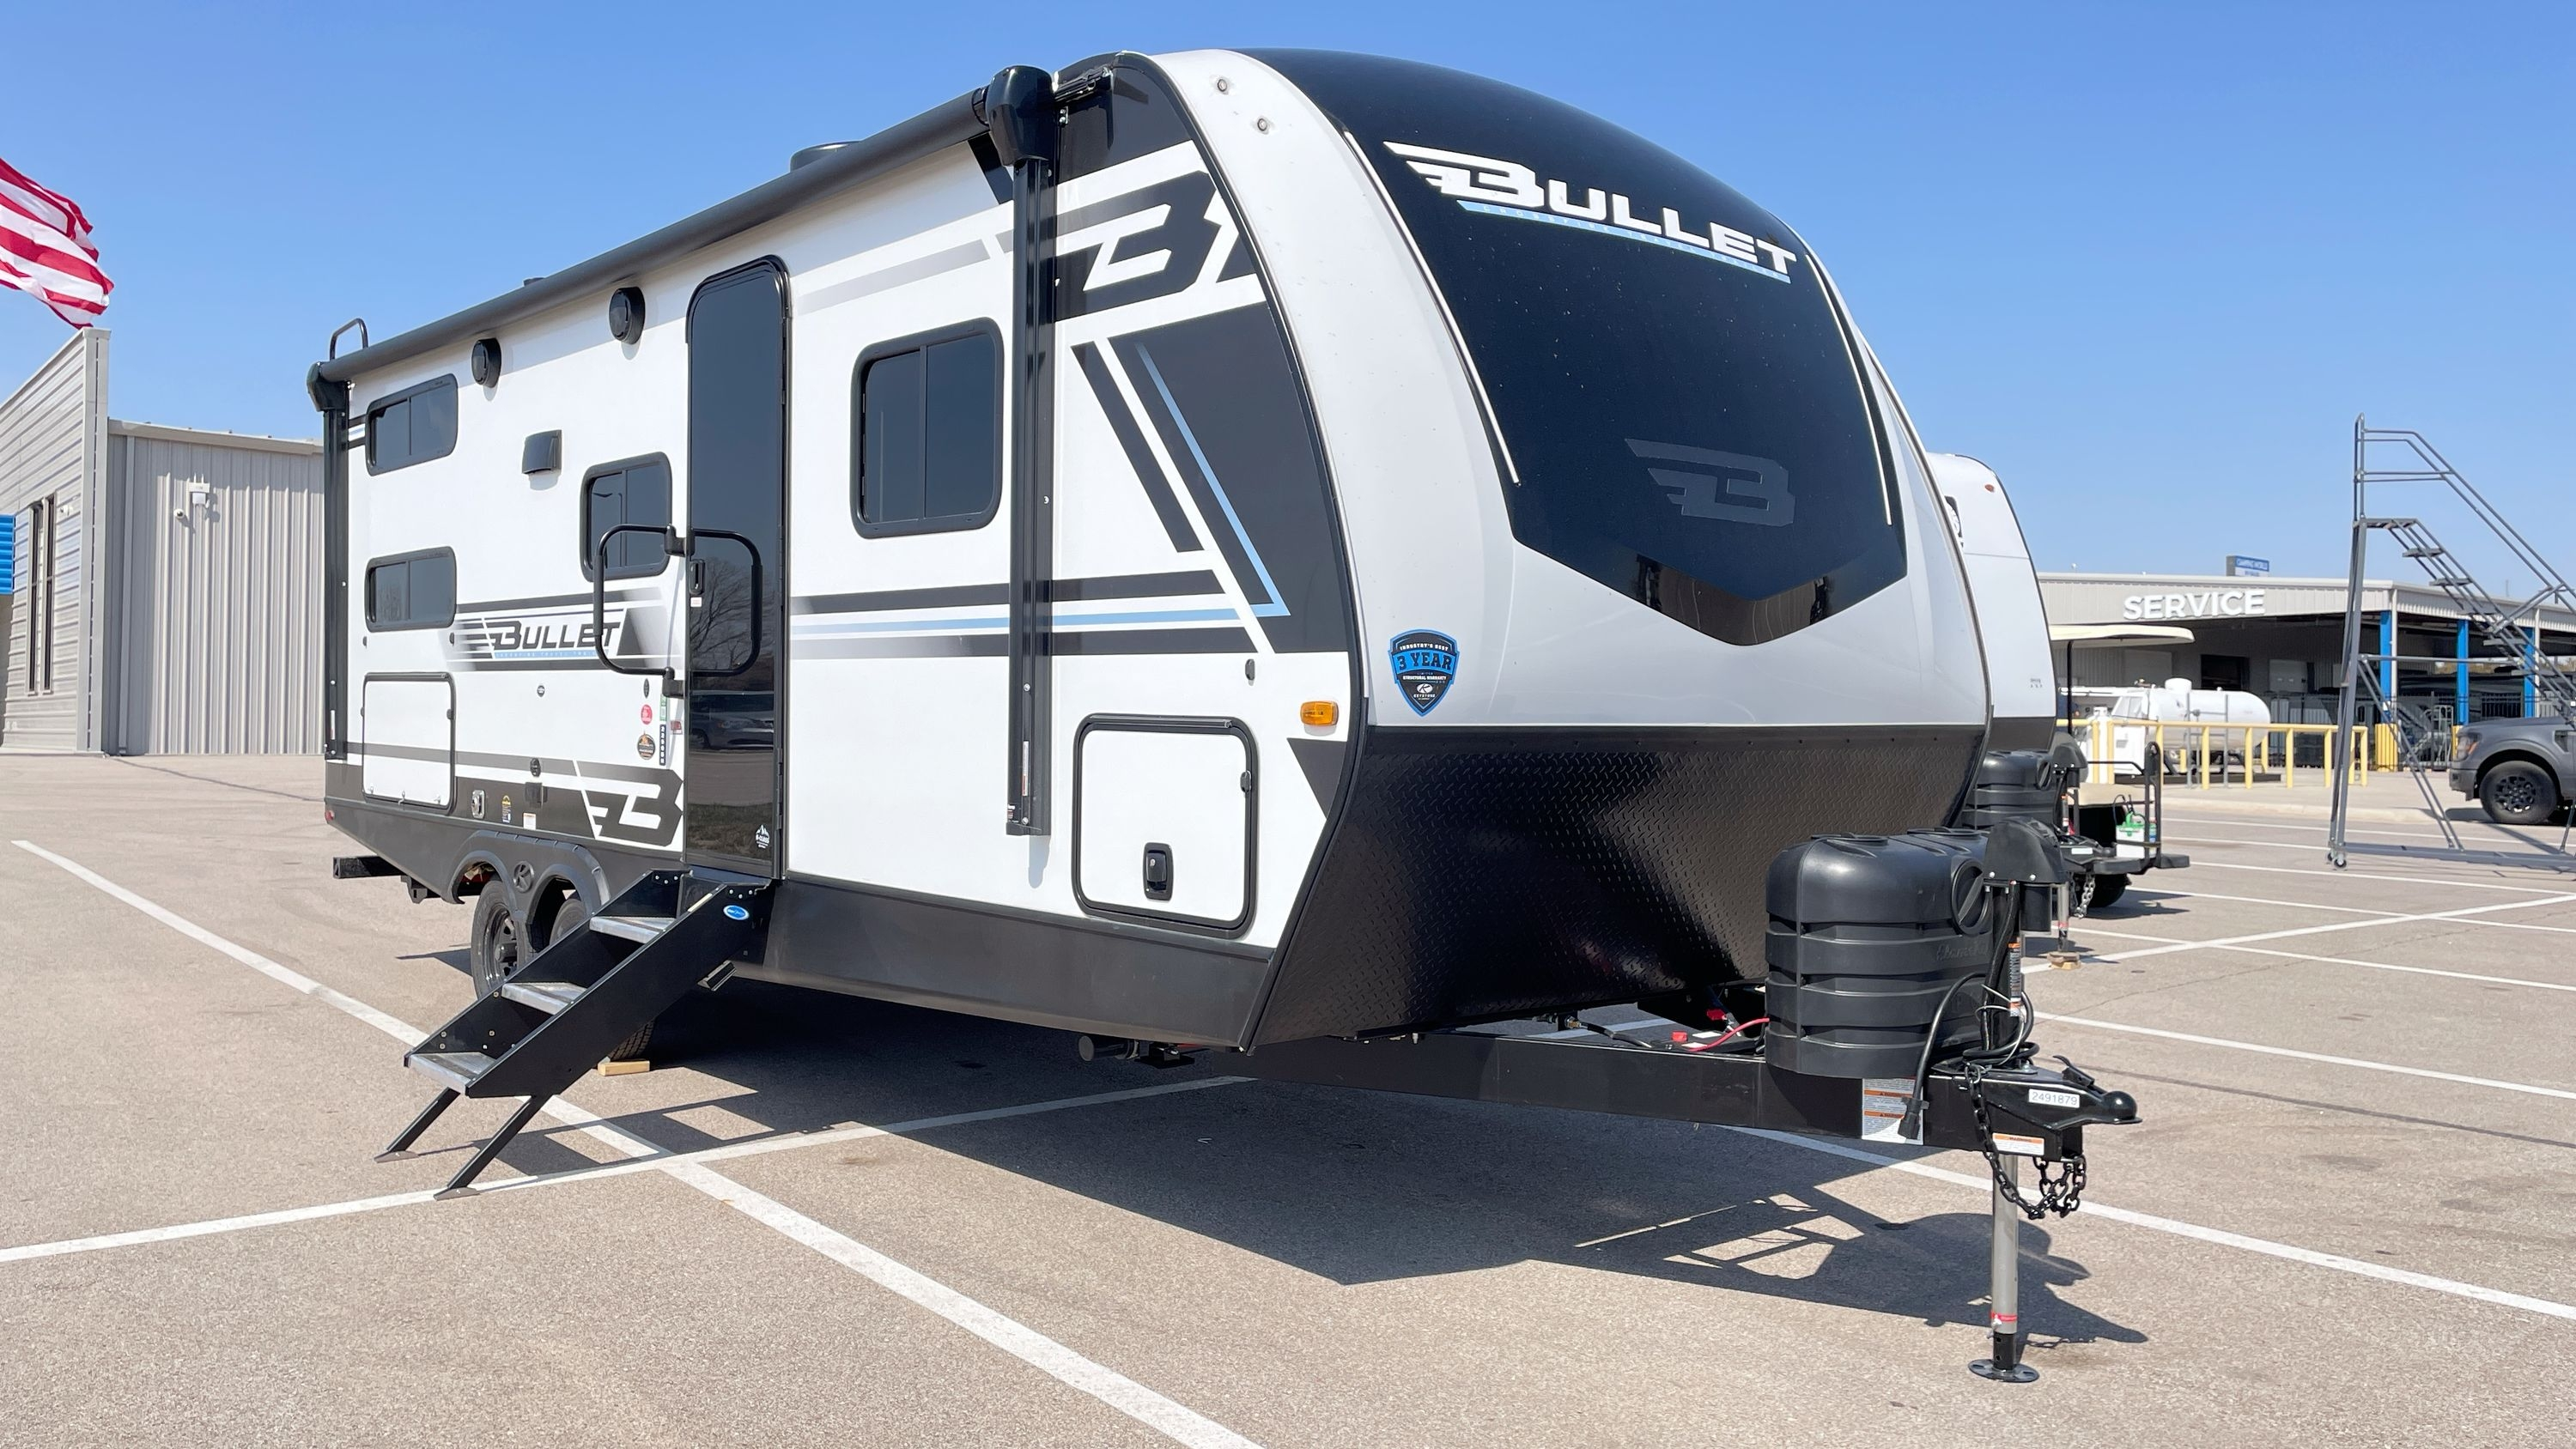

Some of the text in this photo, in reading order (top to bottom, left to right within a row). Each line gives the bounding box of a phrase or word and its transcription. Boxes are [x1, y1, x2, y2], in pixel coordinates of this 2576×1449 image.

[1383, 141, 1796, 275] BULLET
[2123, 589, 2266, 620] SERVICE
[485, 620, 622, 651] BULLET
[1396, 652, 1452, 670] 3 YEAR
[2032, 1091, 2079, 1106] 2491879
